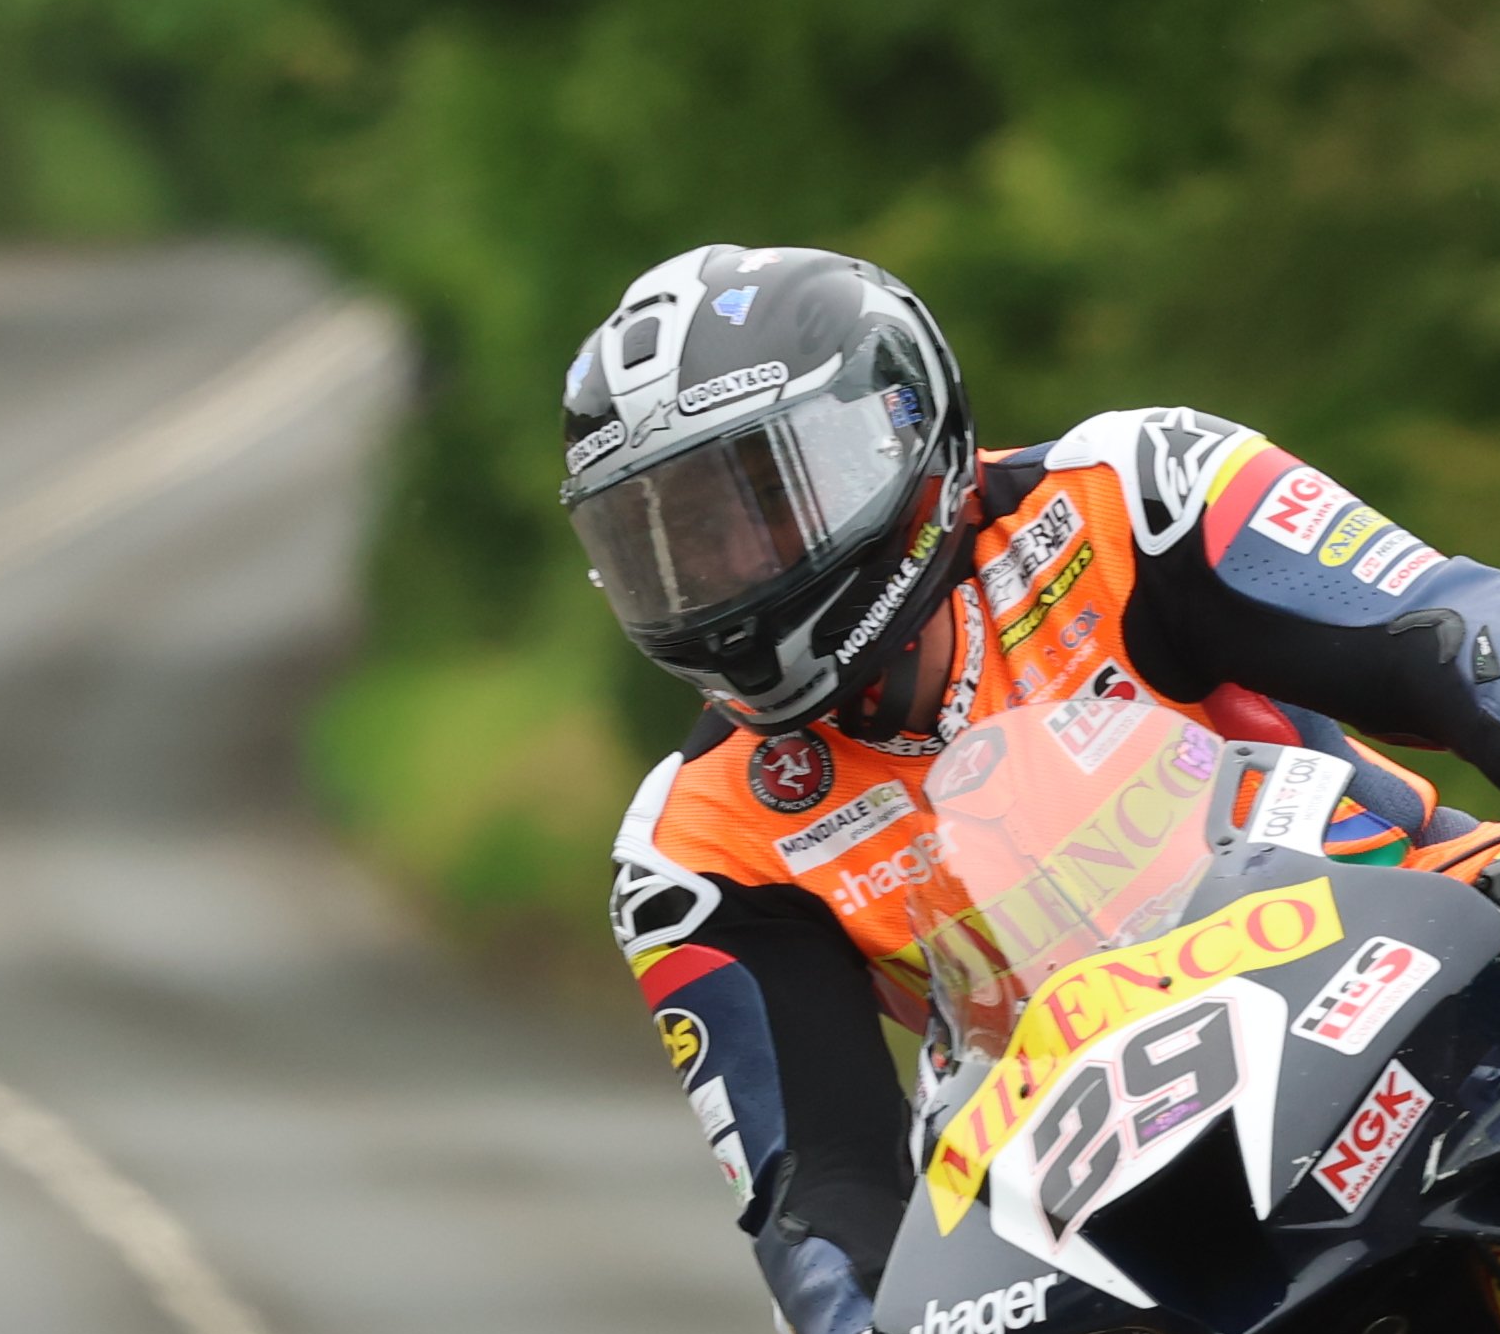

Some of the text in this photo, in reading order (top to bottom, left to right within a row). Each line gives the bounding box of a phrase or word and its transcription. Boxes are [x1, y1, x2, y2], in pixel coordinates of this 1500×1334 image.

[835, 557, 919, 665] MONDIALE
[781, 799, 870, 857] MONDIALE
[940, 898, 1317, 1204] MILENCO
[1031, 999, 1243, 1251] 29
[1318, 1070, 1414, 1194] NGK
[1346, 1152, 1388, 1205] SPARK
